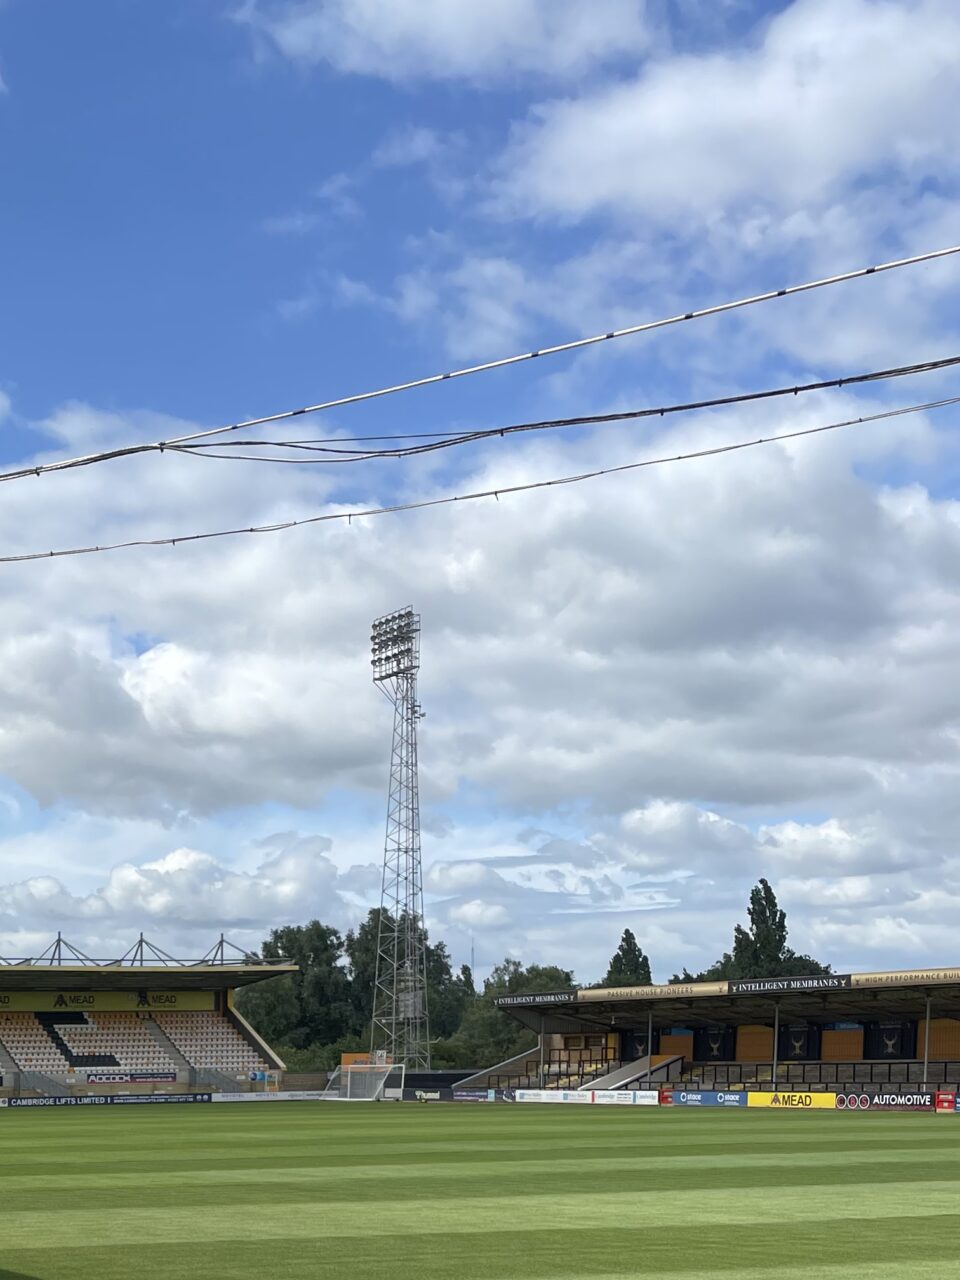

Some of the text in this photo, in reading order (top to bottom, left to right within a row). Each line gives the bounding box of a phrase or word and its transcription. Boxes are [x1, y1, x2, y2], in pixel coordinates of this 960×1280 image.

[885, 972, 940, 983] PERFORMANCE
[739, 978, 839, 992] INTELLIGENT MEMBRANES
[69, 995, 95, 1004] MEAD
[151, 995, 177, 1004] MEAD
[498, 994, 569, 1004] INTELLIGENT MEMBRANES
[88, 1075, 131, 1083] ADCOCK
[11, 1097, 55, 1106] CAMBRIDGE
[56, 1097, 76, 1105] LIFTS
[78, 1096, 105, 1104] LIMITED
[781, 1095, 813, 1106] MEAD
[872, 1095, 931, 1105] AUTOMOTIVE
